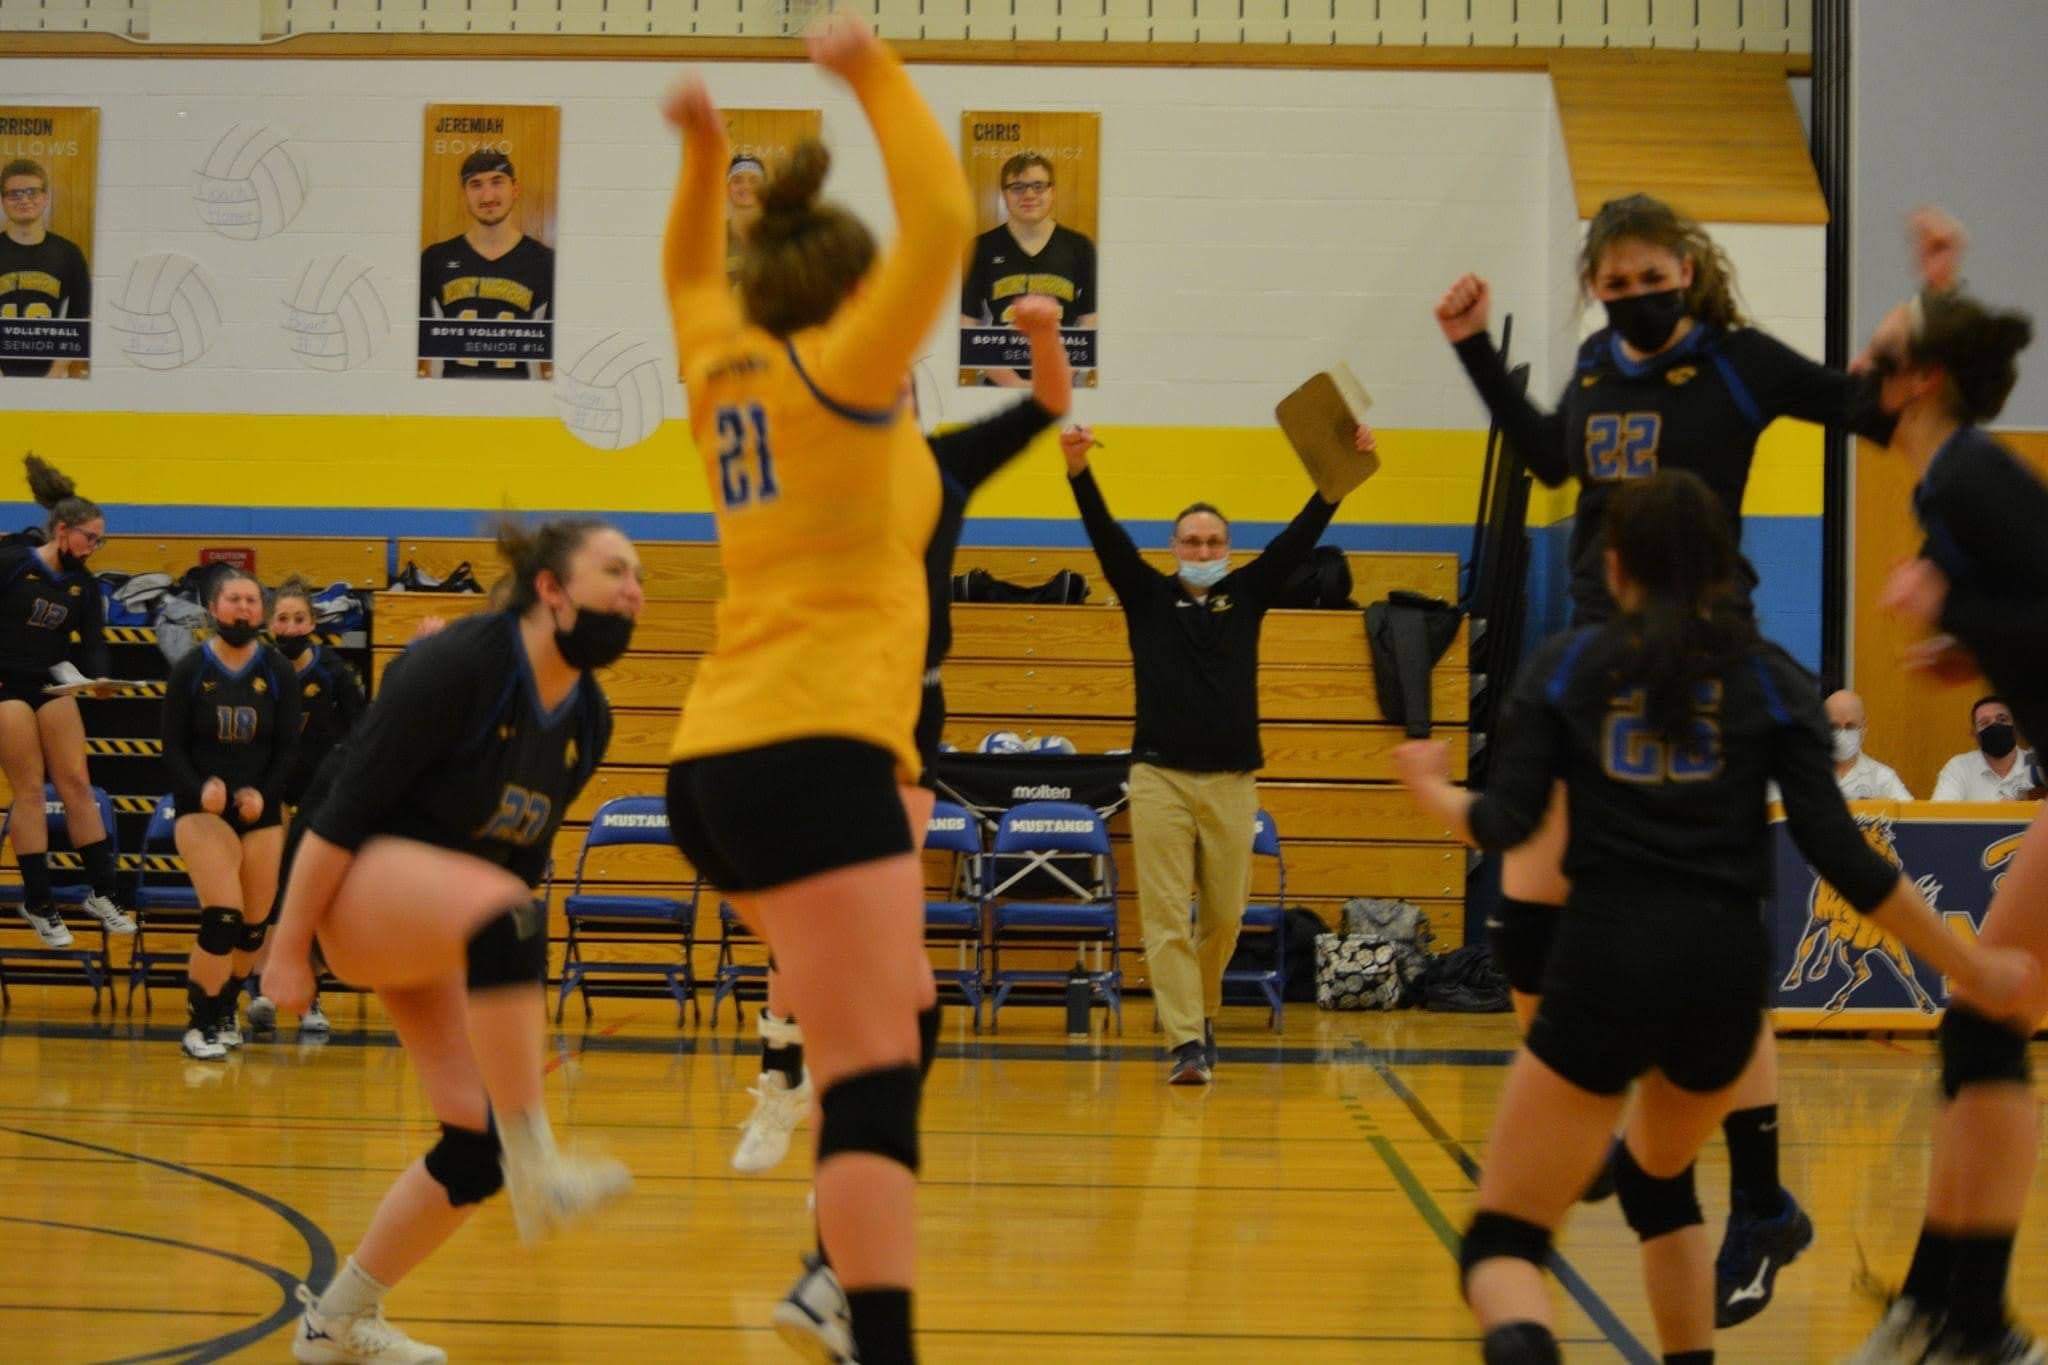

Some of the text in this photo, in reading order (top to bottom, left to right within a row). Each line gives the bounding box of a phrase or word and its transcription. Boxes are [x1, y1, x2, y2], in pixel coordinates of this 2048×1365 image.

[0, 118, 53, 136] RRISON
[435, 118, 504, 134] JEREMIAH
[974, 123, 1021, 141] CHRIS
[2, 140, 79, 156] LLOWS
[434, 140, 513, 155] BOYKO
[4, 326, 80, 337] VOLLEYBALL
[431, 327, 546, 338] BOYS VOLLEYBALL
[3, 340, 54, 351] SENIOR
[464, 342, 516, 352] SENIOR
[973, 335, 1006, 345] BOYS
[1586, 413, 1662, 480] 22
[716, 403, 780, 508] 21
[1012, 785, 1071, 799] molten
[602, 814, 671, 828] MUSTAN
[928, 818, 966, 831] ANGS
[1009, 819, 1094, 833] MUSTANGS
